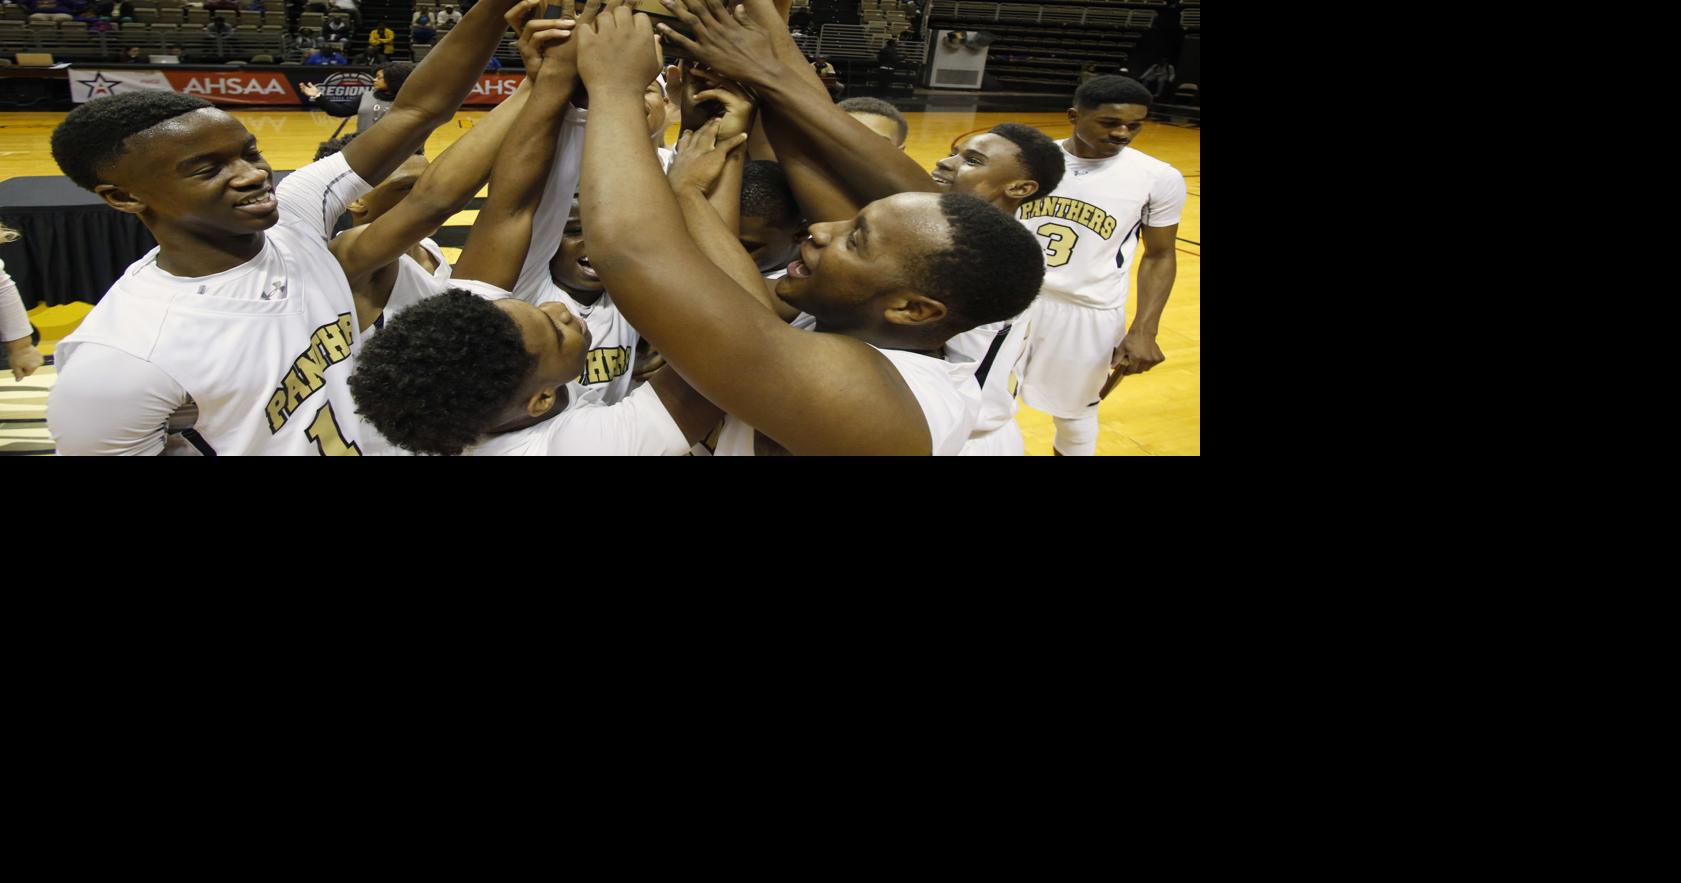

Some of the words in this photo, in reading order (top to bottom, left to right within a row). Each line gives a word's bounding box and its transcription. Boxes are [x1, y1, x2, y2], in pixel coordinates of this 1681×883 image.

[183, 77, 285, 95] AHSAA
[1020, 195, 1117, 240] PANTHERS
[1037, 222, 1079, 267] 3
[304, 399, 363, 456] 1
